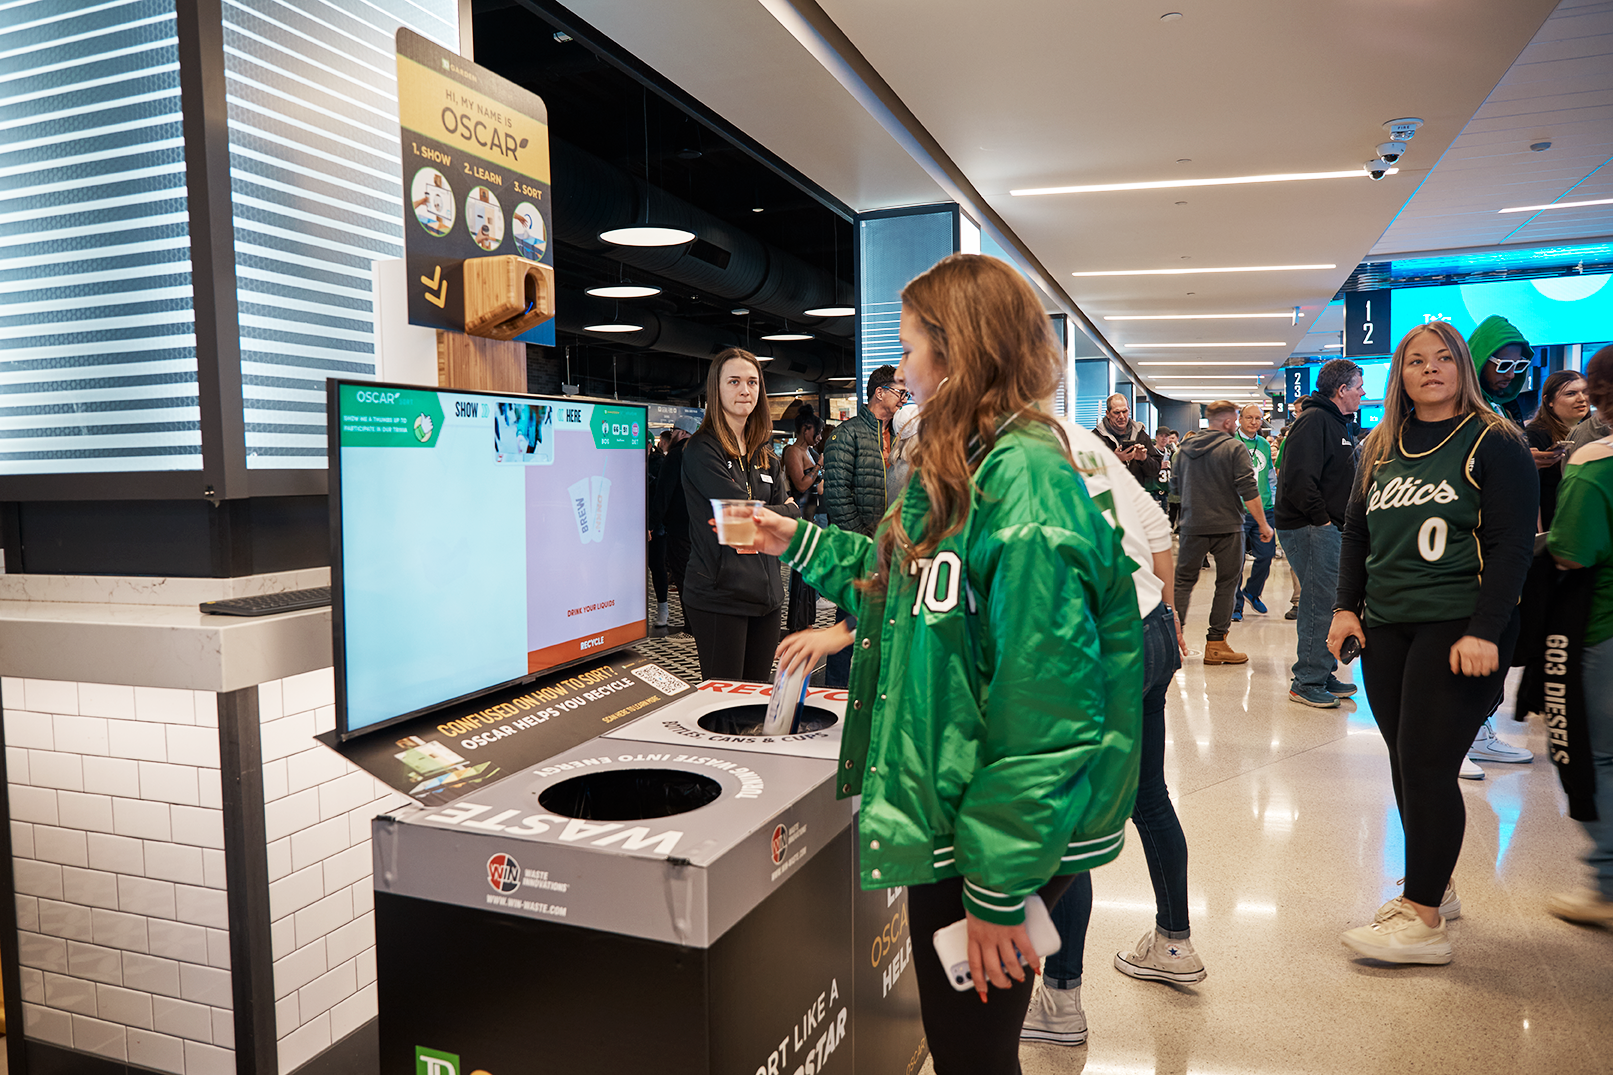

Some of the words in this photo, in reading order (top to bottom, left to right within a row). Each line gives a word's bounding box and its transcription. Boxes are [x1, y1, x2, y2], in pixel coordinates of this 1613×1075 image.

[445, 89, 459, 106] HI,
[461, 96, 474, 111] MY
[477, 104, 502, 125] NAME
[504, 117, 513, 129] IS
[441, 106, 519, 162] OSCAR
[412, 142, 420, 156] 1.
[421, 146, 452, 167] SHOW
[463, 162, 473, 175] 2.
[474, 166, 503, 186] LEARN
[513, 181, 521, 193] 3.
[522, 184, 543, 201] SORT
[1365, 300, 1371, 322] 1
[1362, 322, 1374, 345] 2
[1294, 372, 1301, 385] 2
[356, 390, 395, 405] OSCAR
[1294, 385, 1301, 398] 3
[455, 401, 479, 418] SHOW
[566, 408, 582, 423] HERE
[1277, 402, 1284, 413] 3
[343, 425, 375, 433] PARTICIPATE
[575, 497, 589, 534] BREW
[1418, 516, 1448, 562] 0
[567, 607, 583, 618] DRINK
[583, 603, 597, 613] YOUR
[597, 599, 615, 610] LIQUIDS
[580, 635, 605, 651] RECYCLE
[1544, 634, 1569, 676] 603
[437, 702, 520, 738] CONFUSED
[512, 694, 541, 710] ON
[531, 683, 569, 703] HOW
[560, 677, 586, 691] TO
[578, 665, 618, 685] SORT?
[602, 713, 619, 724] SCAN
[614, 708, 631, 718] HERE
[631, 700, 650, 711] LEARN
[645, 695, 662, 704] MORE
[460, 725, 518, 750] OSCAR
[512, 707, 561, 731] HELPS
[555, 696, 587, 712] YOU
[582, 677, 636, 702] RECYCLE
[708, 735, 757, 744] CANS
[781, 731, 829, 742] CUPS
[533, 756, 613, 778] ENERGY
[617, 753, 671, 762] INTO
[672, 754, 738, 771] WASTE
[424, 802, 684, 855] WASTE
[489, 863, 519, 884] WIN
[524, 868, 549, 880] WASTE
[486, 893, 568, 917] WWW.WIN-WASTE.COM
[882, 935, 912, 999] HELP
[794, 991, 826, 1053] LIKE
[829, 977, 839, 1008] A
